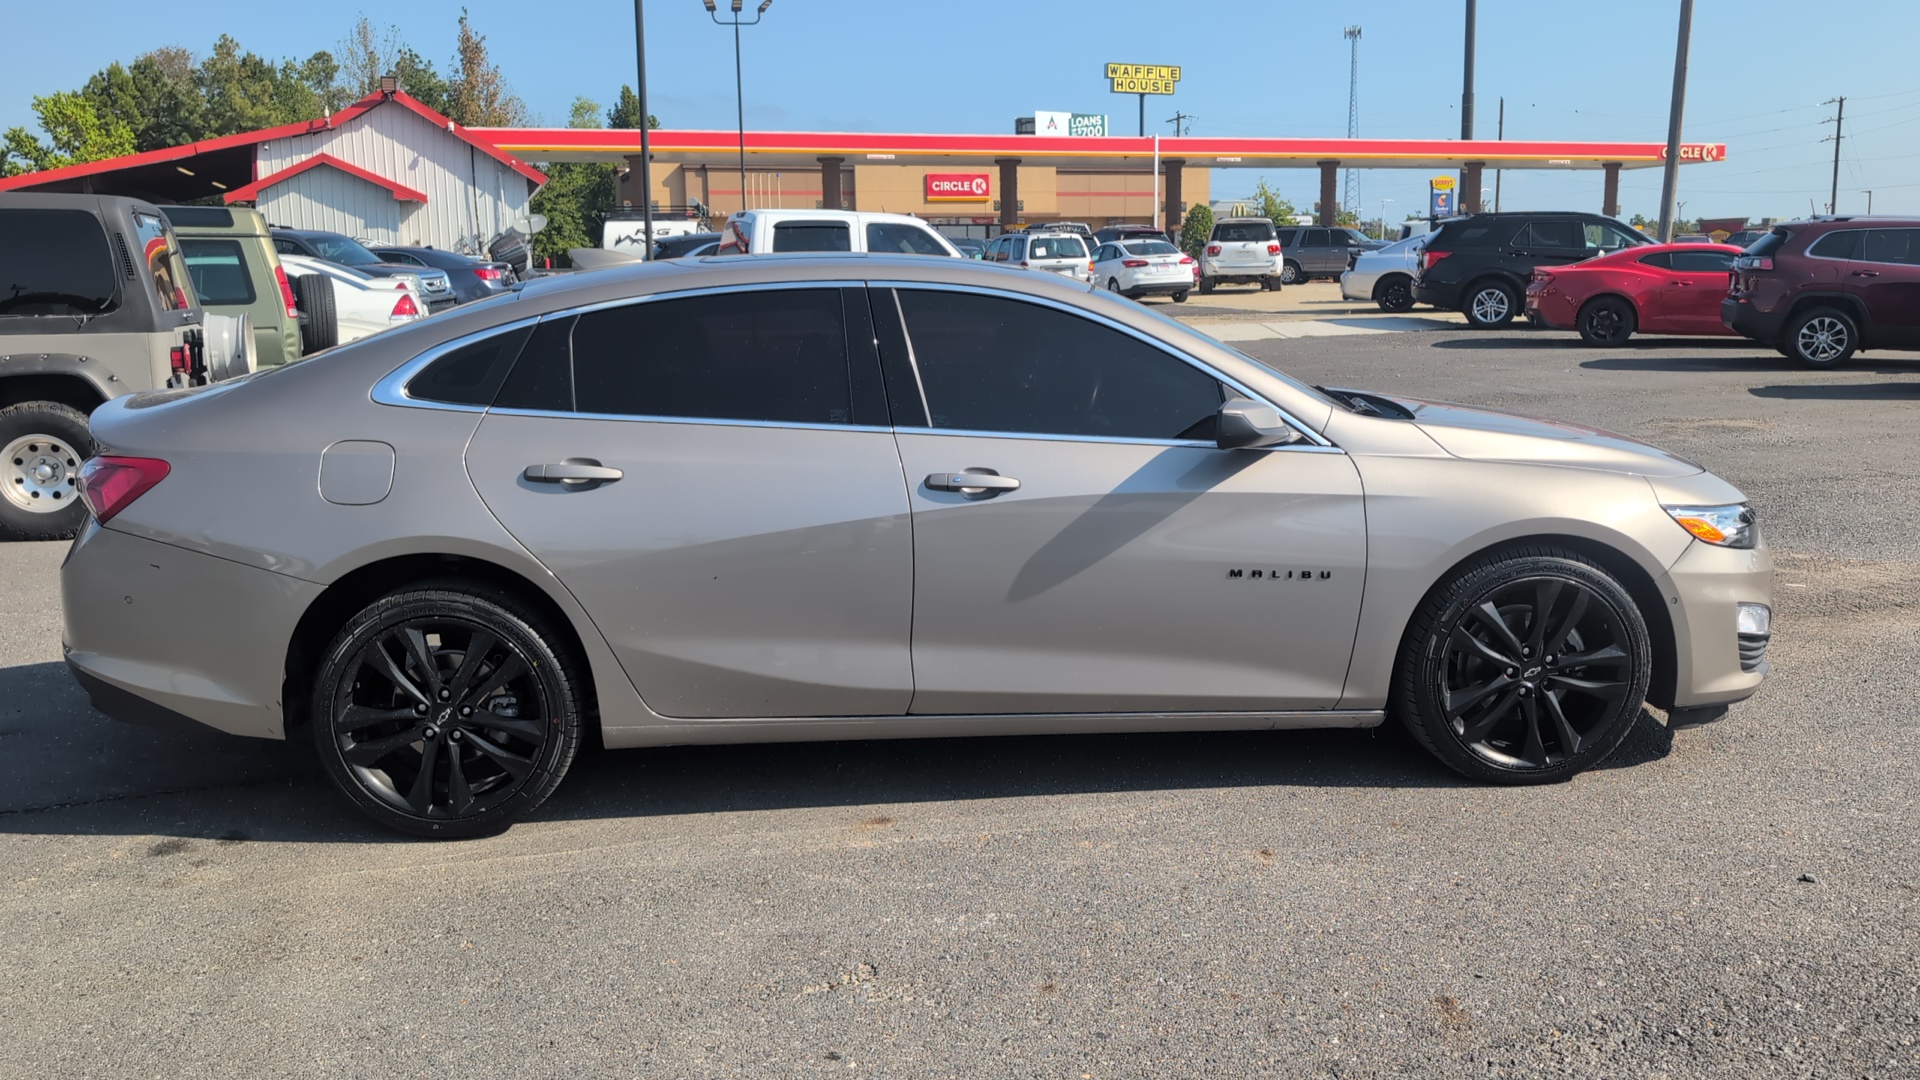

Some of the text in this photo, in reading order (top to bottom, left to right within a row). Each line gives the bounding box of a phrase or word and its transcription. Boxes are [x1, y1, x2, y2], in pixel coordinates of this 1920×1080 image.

[1109, 65, 1178, 79] WAFFLE
[1116, 80, 1171, 92] HOUSE
[1071, 115, 1102, 127] LOANS
[1078, 126, 1103, 136] $700
[1661, 141, 1716, 160] CCLE K
[932, 179, 986, 193] CIRCLE K
[1228, 569, 1332, 579] MALIBU
